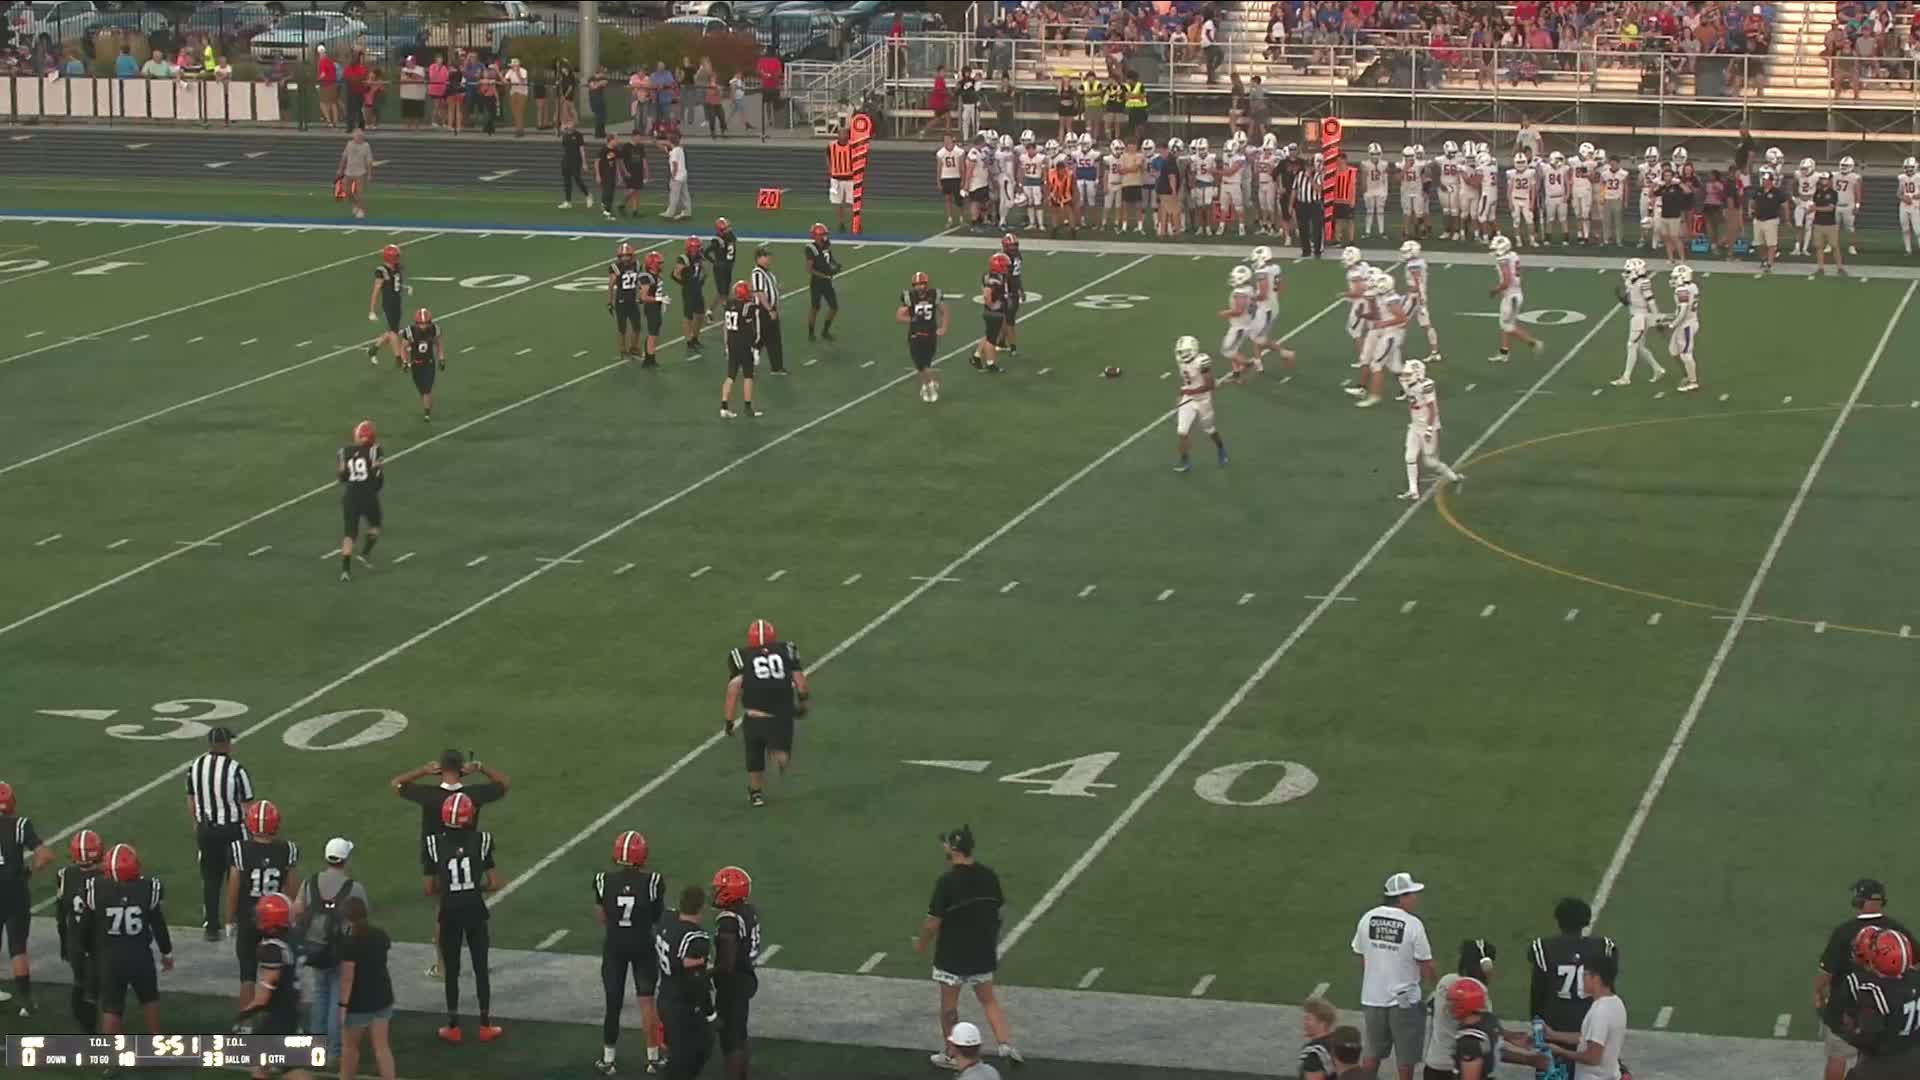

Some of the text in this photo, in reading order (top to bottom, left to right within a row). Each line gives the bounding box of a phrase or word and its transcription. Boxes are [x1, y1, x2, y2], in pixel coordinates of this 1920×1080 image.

[1025, 163, 1037, 175] 27
[1515, 178, 1528, 189] 32
[1607, 179, 1619, 190] 33
[1836, 180, 1849, 191] 57
[1904, 182, 1915, 193] 10
[760, 191, 776, 206] 20
[621, 273, 637, 289] 27
[725, 311, 739, 330] 87
[347, 458, 368, 482] 19
[753, 653, 786, 679] 60
[250, 867, 280, 897] 16
[448, 856, 475, 891] 11
[616, 896, 635, 927] 7
[105, 906, 142, 935] 76
